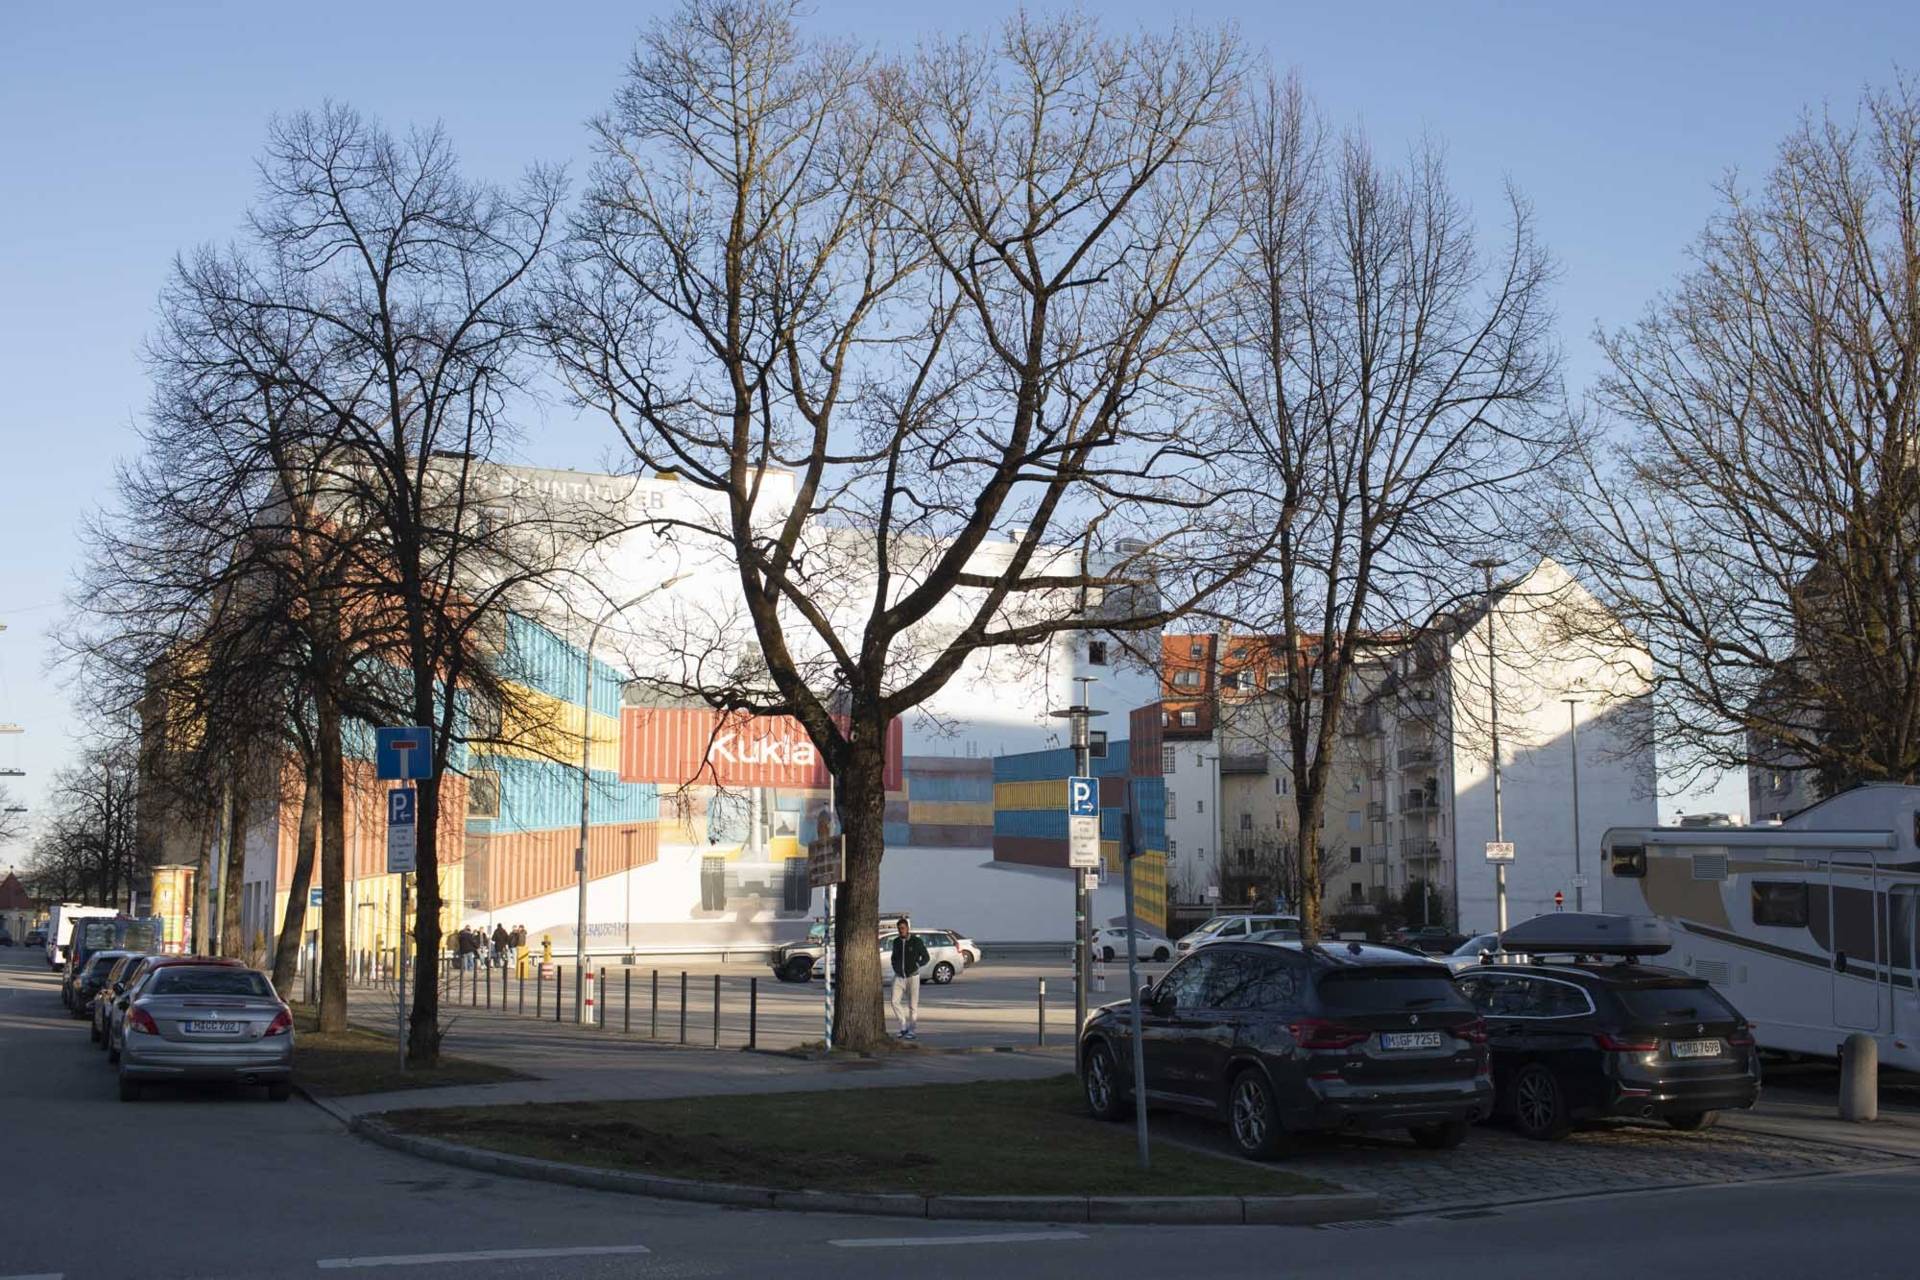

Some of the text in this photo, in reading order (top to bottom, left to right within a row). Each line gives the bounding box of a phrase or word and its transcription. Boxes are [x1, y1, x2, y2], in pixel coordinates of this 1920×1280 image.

[707, 732, 815, 766] Kukla
[392, 793, 408, 821] P
[1074, 782, 1091, 812] P
